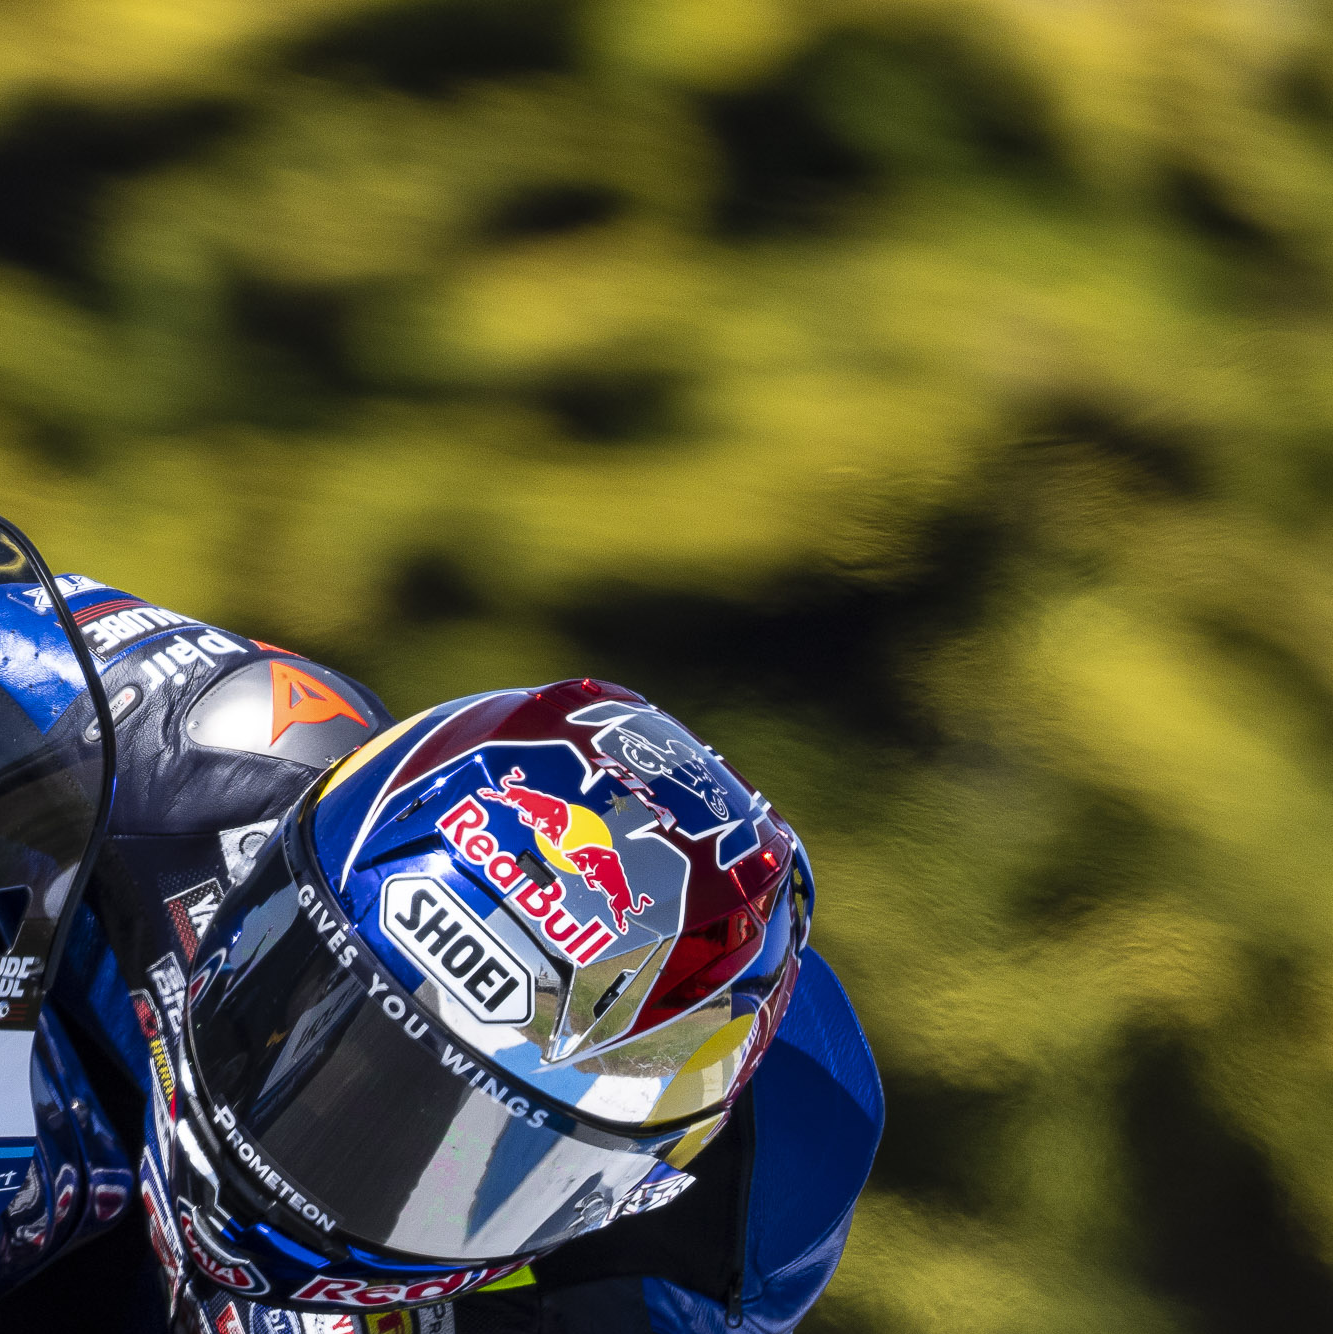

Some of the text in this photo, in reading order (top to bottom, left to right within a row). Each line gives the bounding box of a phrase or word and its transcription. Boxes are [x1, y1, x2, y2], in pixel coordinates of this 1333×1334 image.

[395, 888, 520, 1015] SHOEI
[435, 794, 618, 968] Red Bull
[297, 884, 359, 969] GIVES
[366, 972, 430, 1041] YOU
[441, 1045, 550, 1130] WINGS
[213, 1104, 336, 1232] PROMETEON
